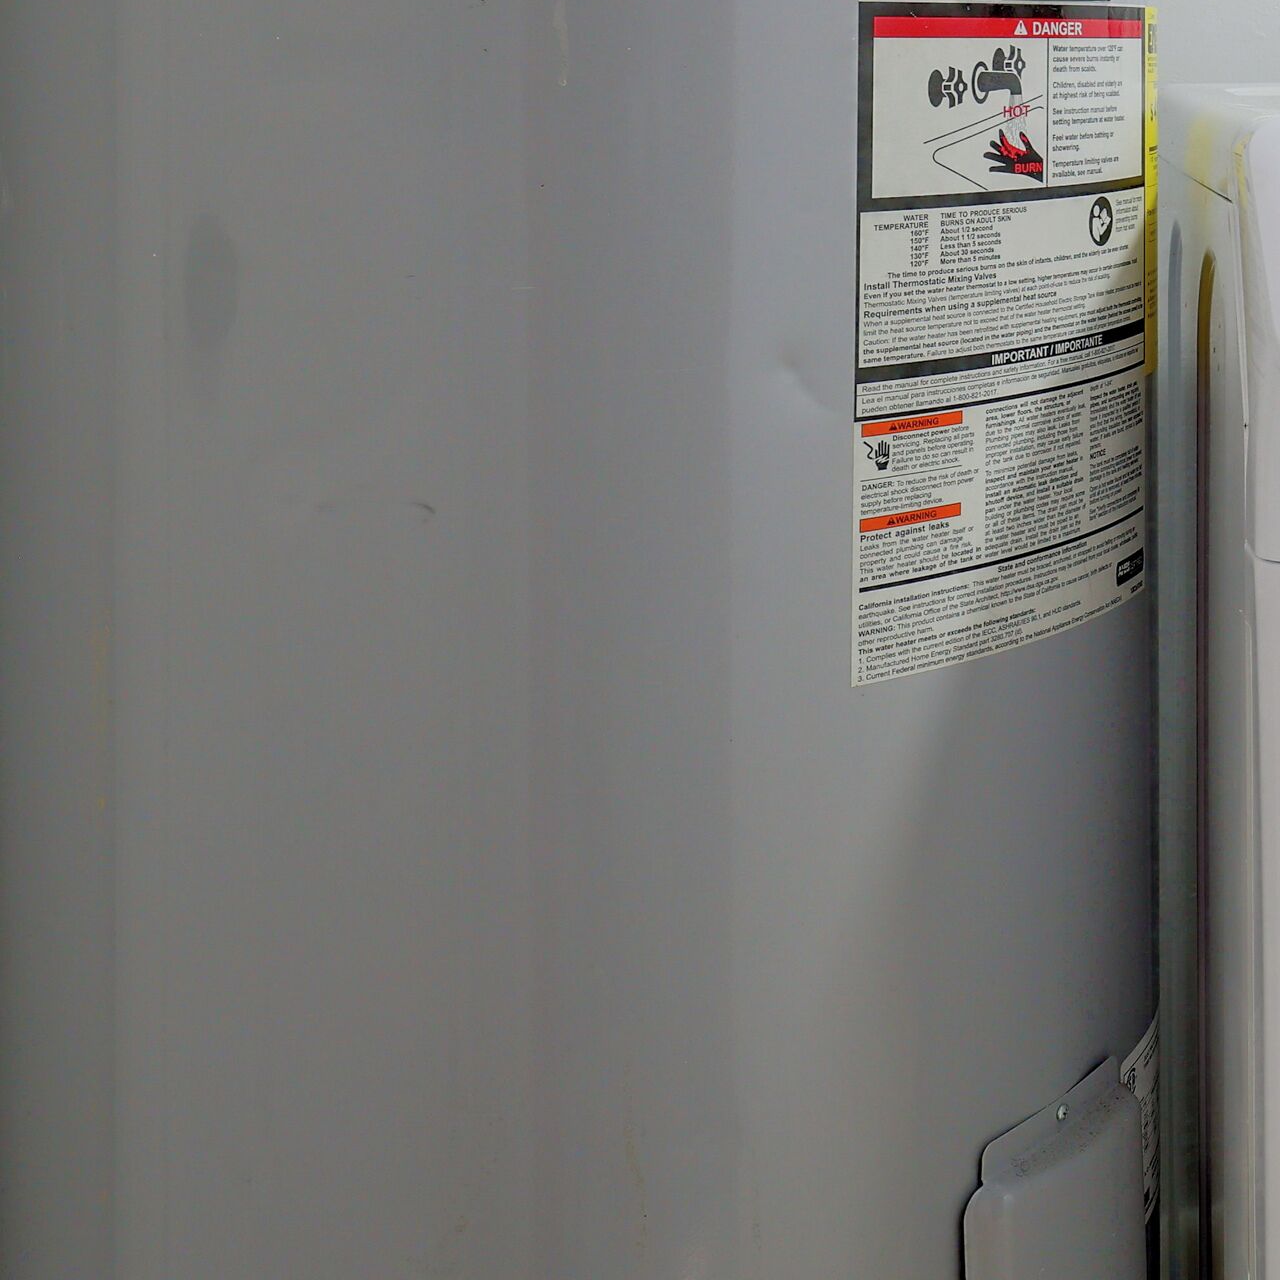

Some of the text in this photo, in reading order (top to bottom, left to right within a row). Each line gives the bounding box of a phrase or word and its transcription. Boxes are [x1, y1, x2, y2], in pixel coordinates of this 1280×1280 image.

[1032, 21, 1083, 36] DANGER
[1003, 105, 1031, 118] HOT
[1014, 163, 1043, 174] BURN
[903, 214, 929, 222] WATER
[941, 212, 957, 220] TIME
[970, 208, 1000, 217] PRODUCE
[1002, 206, 1028, 215] SERIOUS
[874, 221, 929, 231] TEMPERATURE
[941, 219, 964, 227] BURNS
[976, 216, 996, 224] ADULT
[997, 215, 1012, 223] SKIN
[940, 227, 960, 235] About
[940, 234, 960, 242] About
[976, 231, 1001, 239] seconds
[940, 242, 956, 250] Less
[977, 238, 1002, 246] seconds
[940, 250, 960, 258] About
[970, 247, 994, 255] seconds
[863, 272, 997, 291] Install Thermostatic Mixing Valves
[863, 306, 923, 319] Requirements
[924, 304, 946, 313] when
[948, 301, 970, 311] using
[977, 295, 1022, 308] supplemental
[1023, 293, 1037, 301] heat
[1037, 291, 1057, 300] source
[991, 346, 1049, 366] IMPORTANT
[1055, 334, 1103, 354] IMPORTANTE
[897, 417, 940, 430] WARNING
[892, 425, 970, 441] Disconnect power before
[861, 480, 895, 491] DANGER:
[895, 510, 937, 523] WARNING
[860, 521, 950, 542] Protect against leaks
